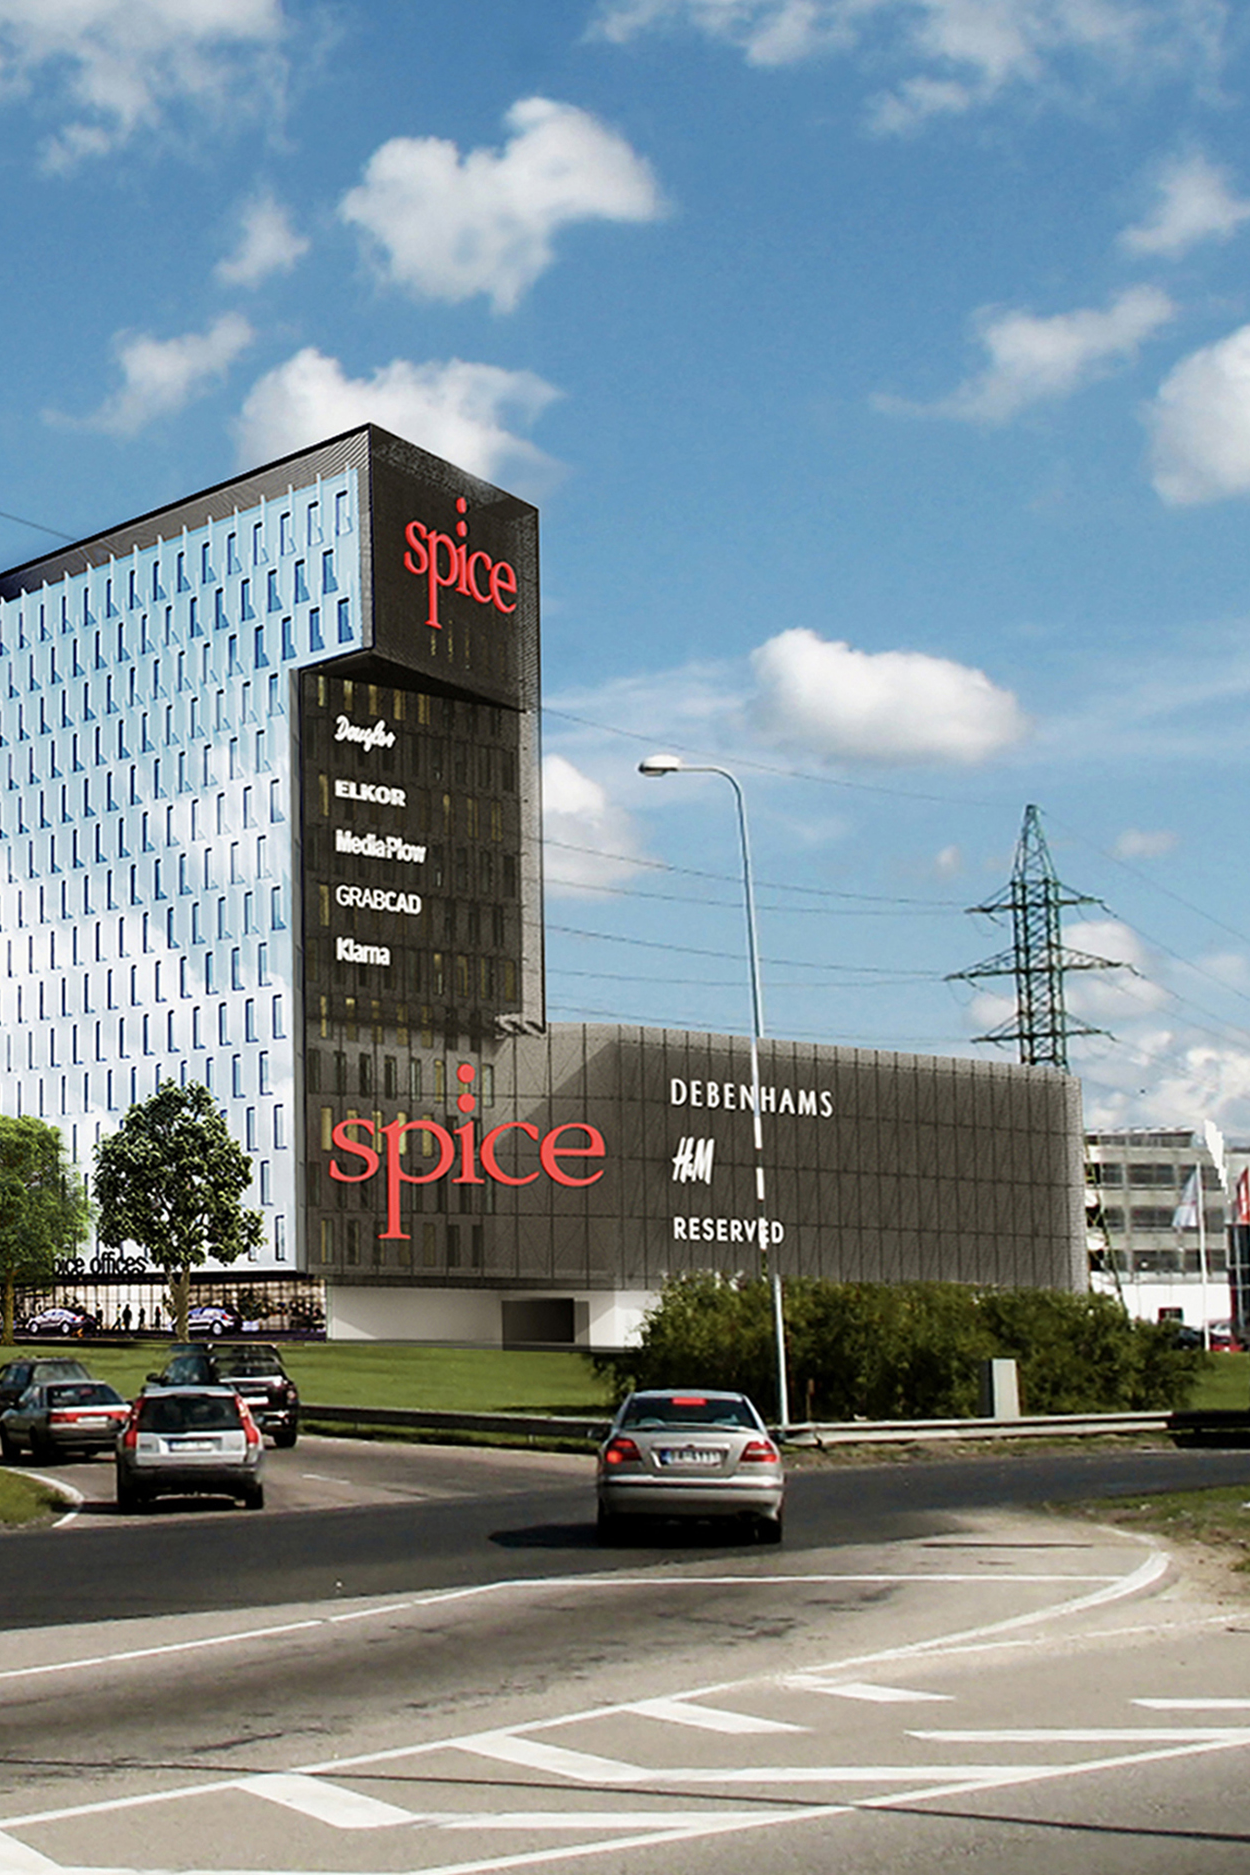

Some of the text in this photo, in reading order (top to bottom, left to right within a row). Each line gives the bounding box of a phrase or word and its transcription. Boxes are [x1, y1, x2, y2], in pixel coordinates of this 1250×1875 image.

[403, 497, 517, 630] spice
[335, 779, 406, 807] ELKOR
[336, 885, 422, 915] GRABCAD
[336, 937, 390, 966] Klarna
[670, 1078, 834, 1118] DEBENHAMS
[328, 1063, 606, 1240] spice
[672, 1136, 715, 1185] H&M
[673, 1216, 784, 1244] RESERVED
[90, 1251, 147, 1275] offices
